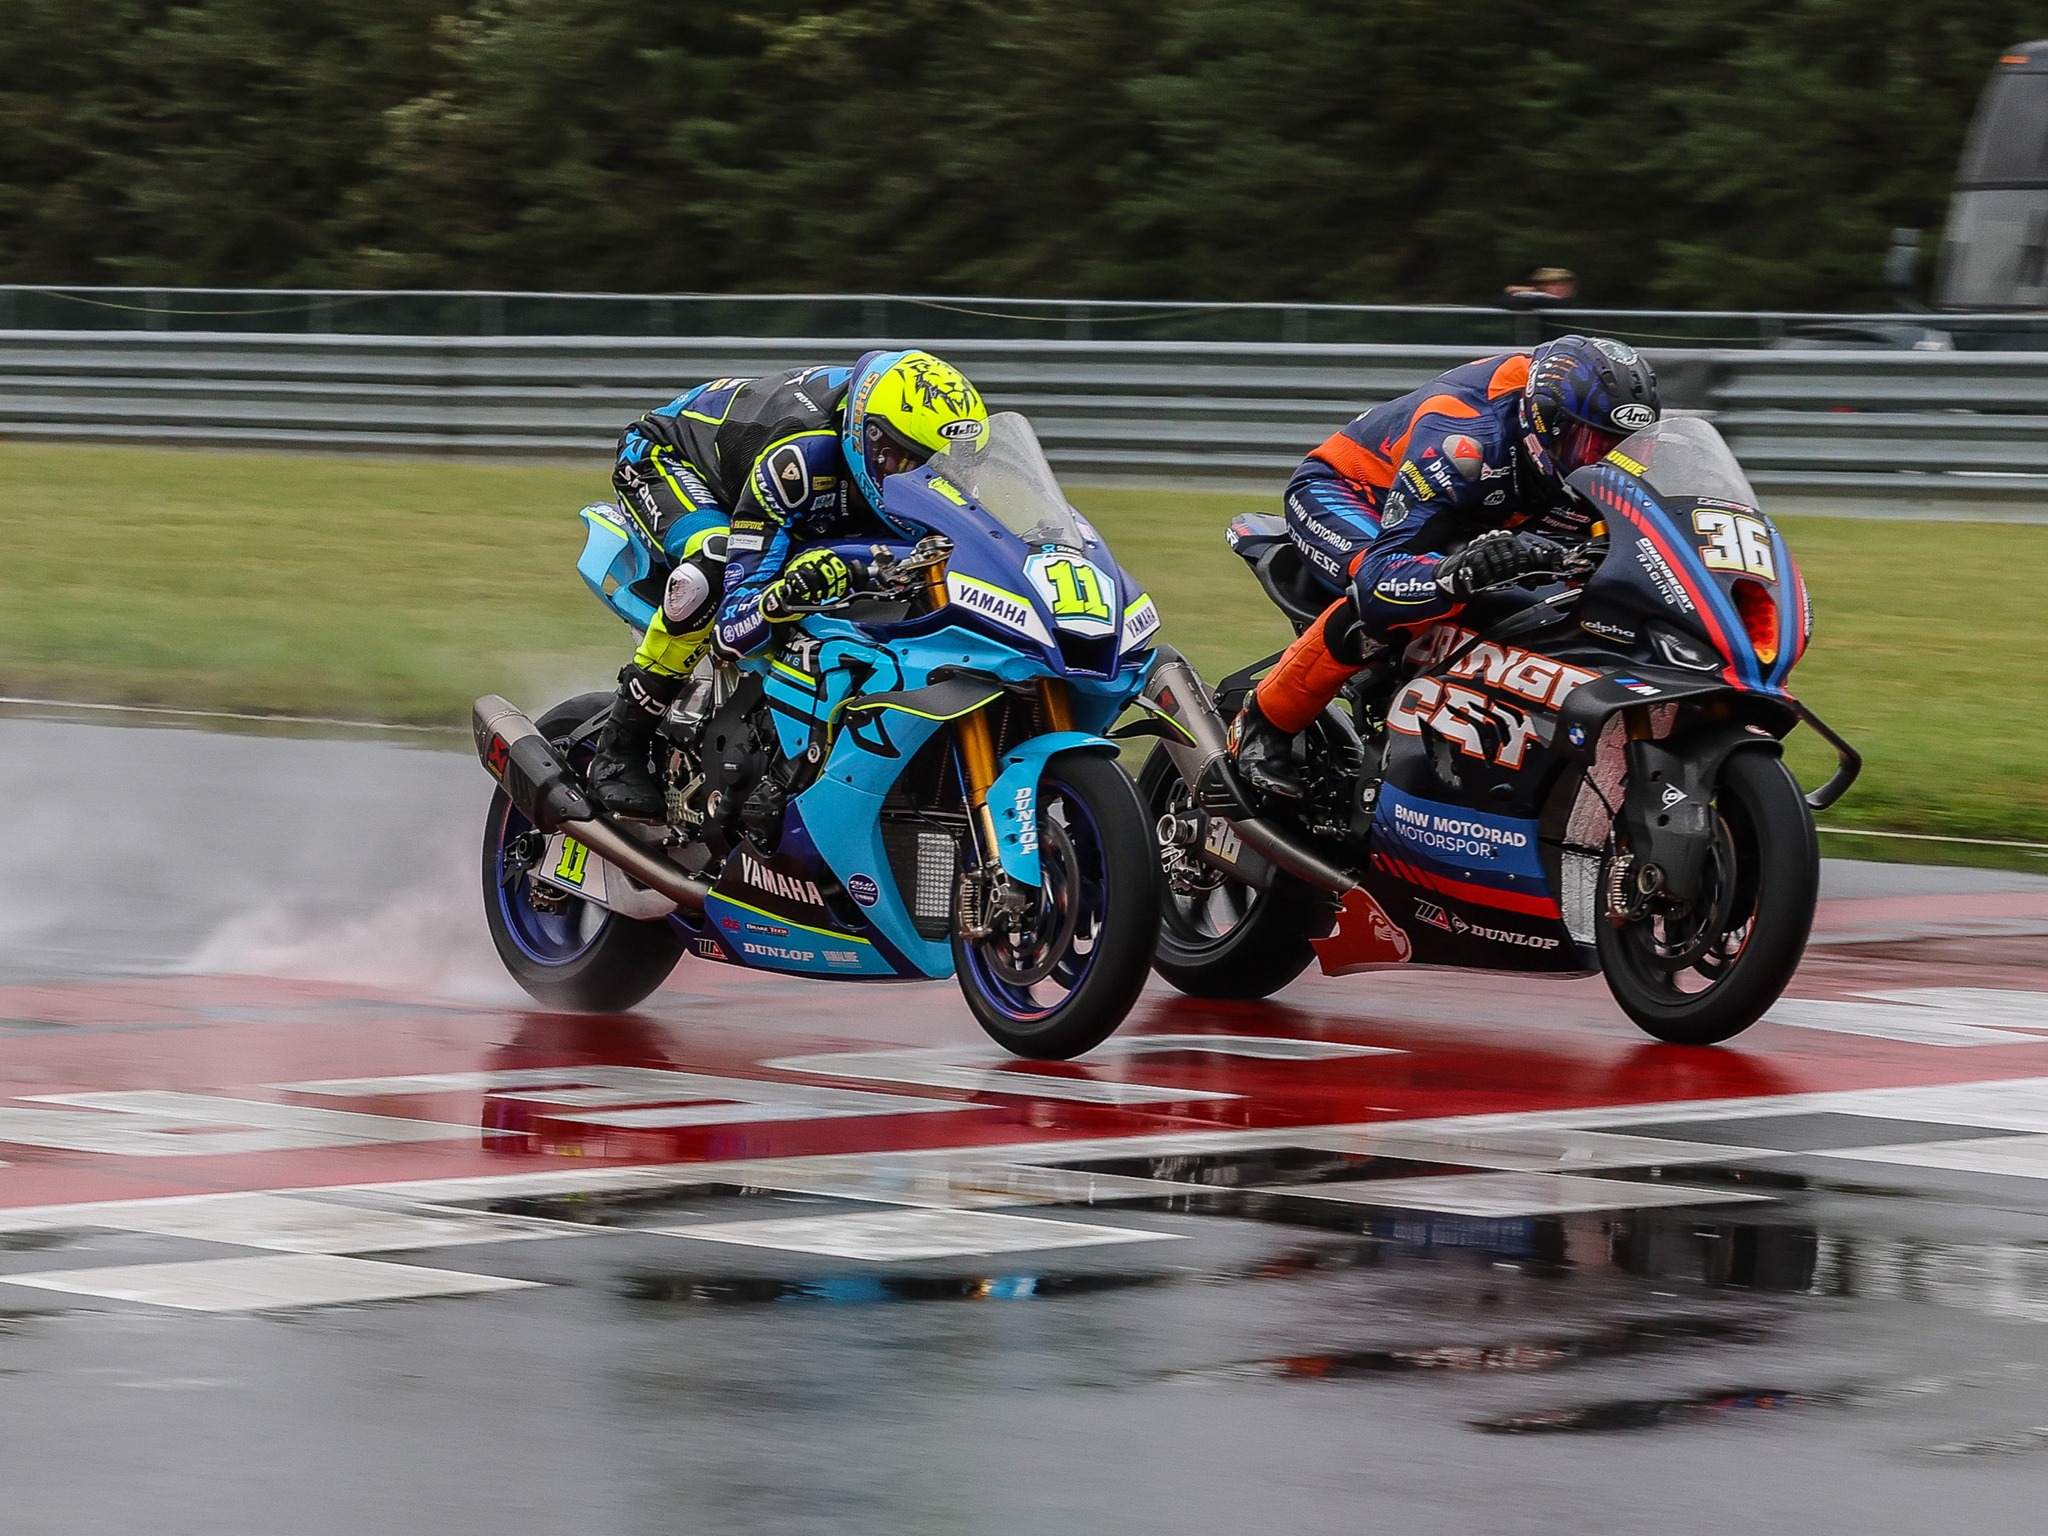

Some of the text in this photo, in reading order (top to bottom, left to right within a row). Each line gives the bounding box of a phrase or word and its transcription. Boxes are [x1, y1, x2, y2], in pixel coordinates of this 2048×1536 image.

[945, 423, 979, 436] HJC
[1288, 493, 1353, 552] BMW MOTORRAD
[1692, 509, 1778, 585] 36
[1045, 559, 1110, 619] 11
[1376, 578, 1437, 597] alpha
[1635, 553, 1676, 605] RACING
[960, 584, 1028, 627] YAMAHA
[1125, 606, 1158, 638] YAMAHA
[1584, 620, 1636, 639] alpha
[1014, 787, 1039, 855] DUNLOP
[1395, 804, 1430, 828] BMW
[554, 836, 589, 887] 11
[1204, 816, 1242, 864] 36
[741, 853, 825, 907] YAMAHA
[742, 942, 815, 962] DUNLOP
[1470, 924, 1560, 950] DUNLOP
